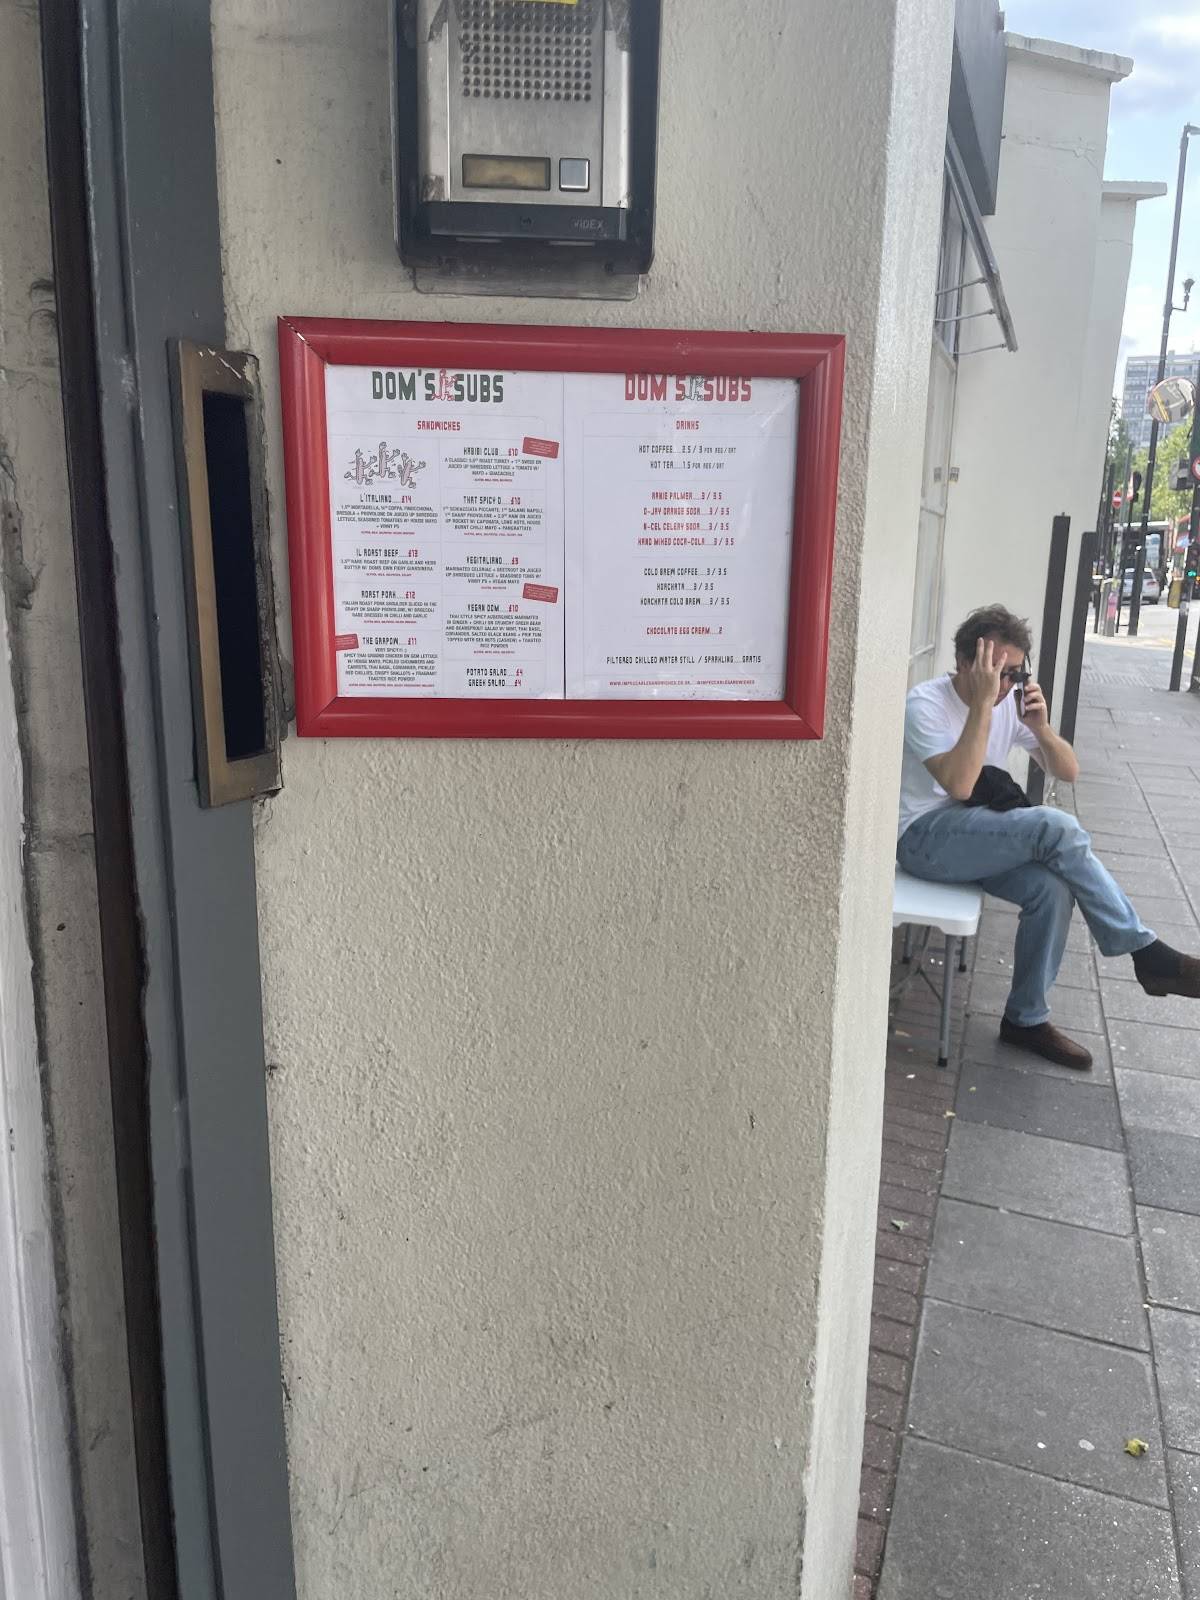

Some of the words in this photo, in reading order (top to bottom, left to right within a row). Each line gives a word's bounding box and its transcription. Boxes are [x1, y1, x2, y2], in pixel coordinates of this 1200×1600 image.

[372, 368, 435, 401] DOM'S
[454, 374, 504, 403] SUBS
[704, 376, 752, 402] SUBS
[417, 421, 461, 431] SANDWICHES
[676, 421, 699, 430] DRINKS
[638, 445, 649, 453] HOT
[650, 461, 661, 469] HOT
[463, 496, 477, 504] THAT
[663, 507, 684, 515] ORANGE
[662, 522, 684, 530] CELERY
[654, 538, 672, 546] MIXED
[356, 548, 362, 557] IL
